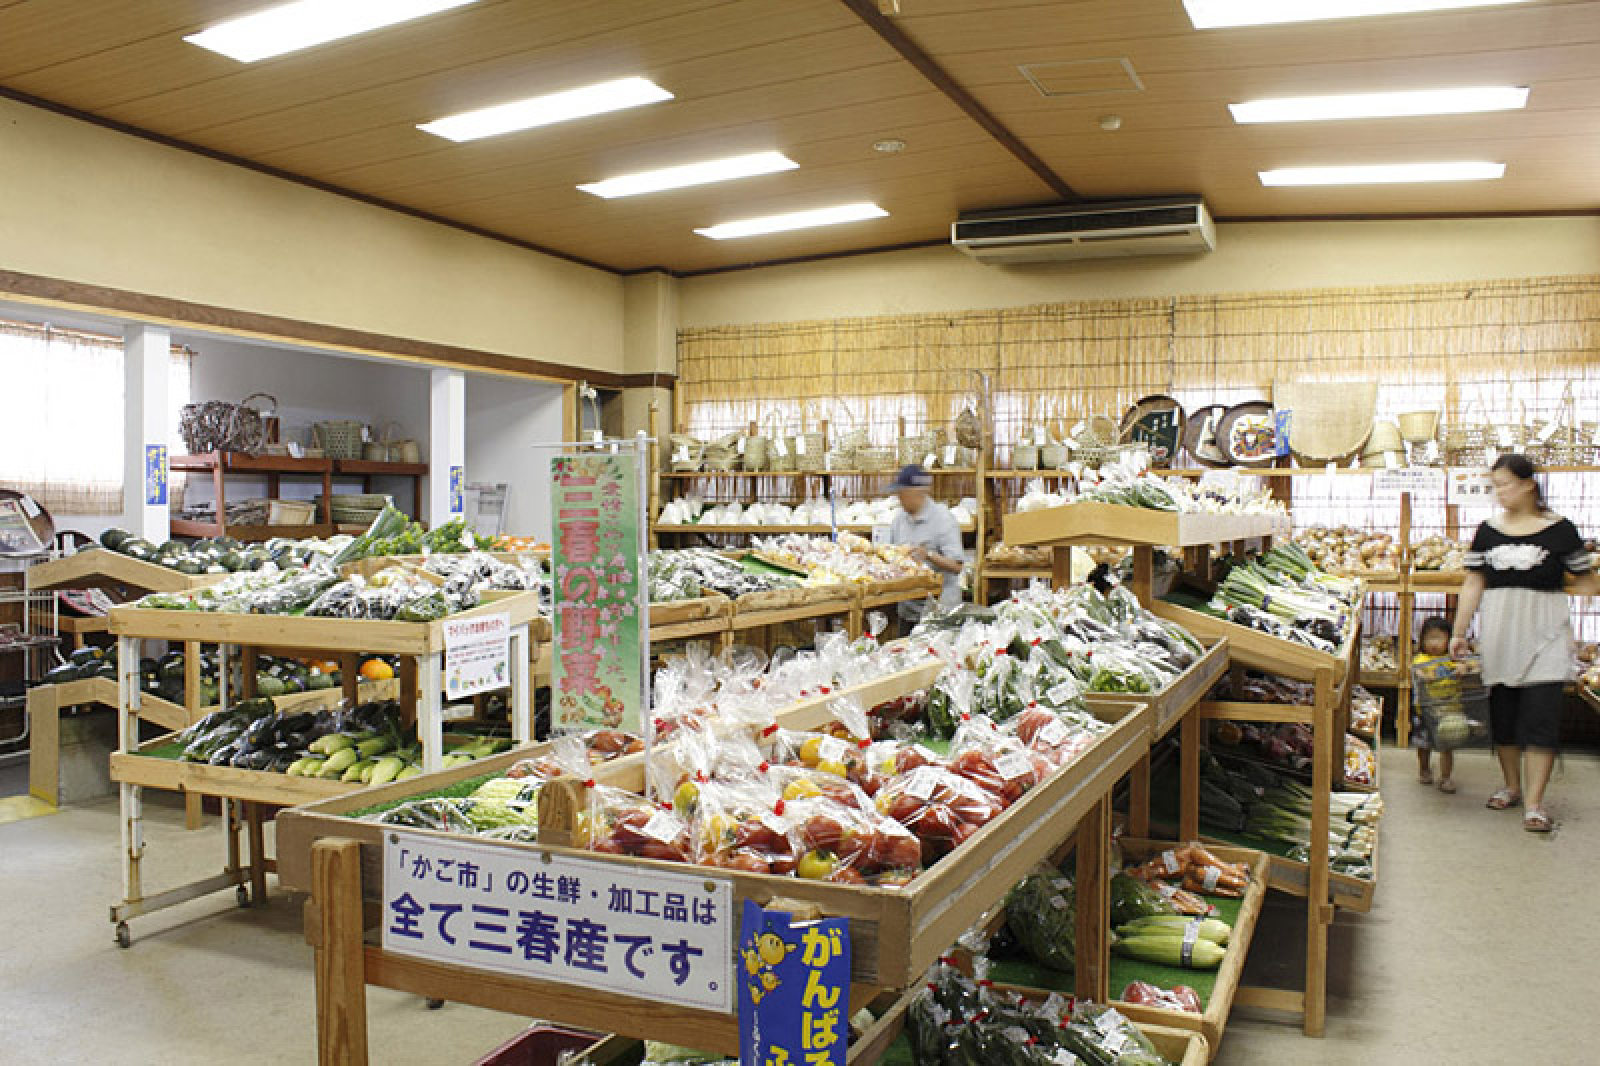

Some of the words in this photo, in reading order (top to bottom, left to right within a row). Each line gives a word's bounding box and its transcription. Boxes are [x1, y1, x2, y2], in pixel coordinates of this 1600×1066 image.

[559, 476, 601, 696] 三春の野菜
[398, 848, 718, 926] 「かご市」の生鮮・加工品は
[389, 891, 719, 992] 全て三春産です。
